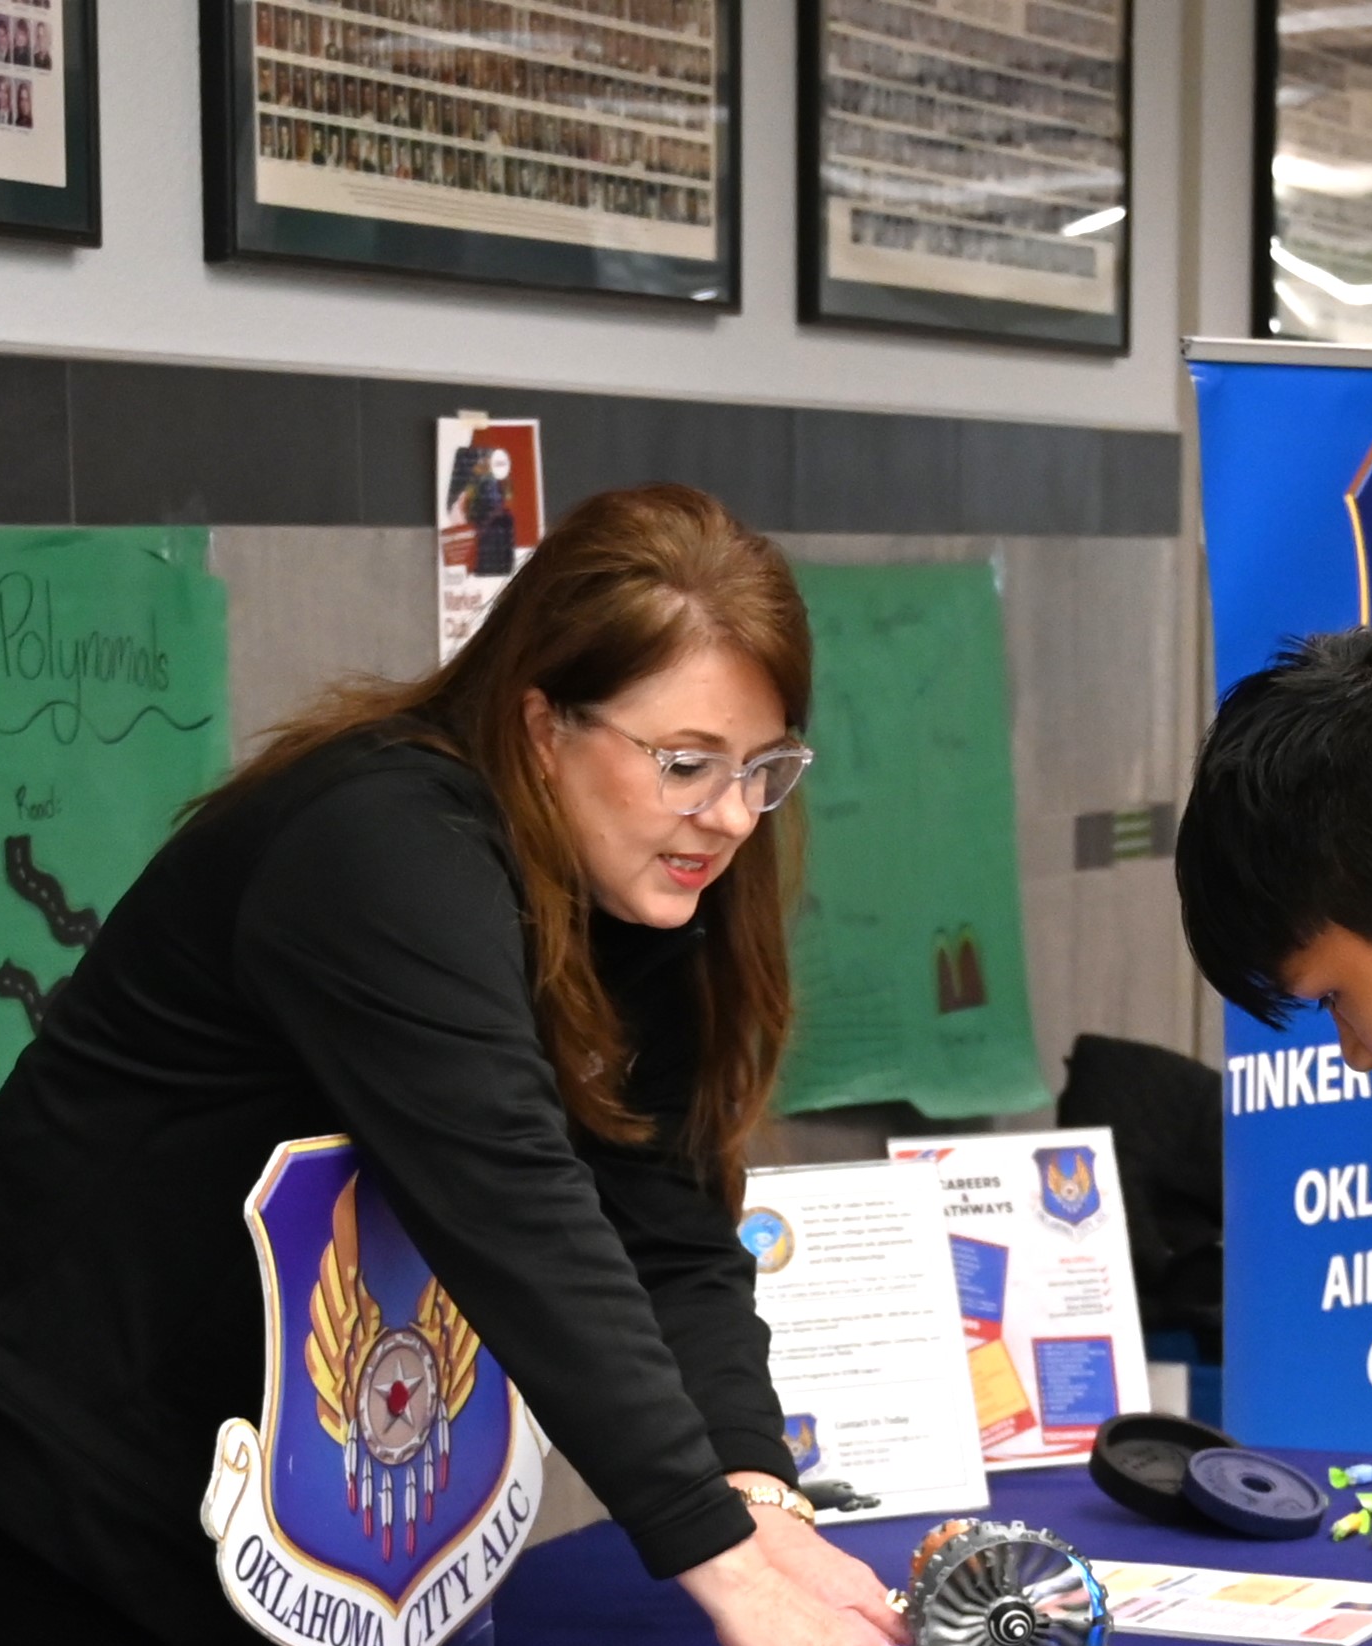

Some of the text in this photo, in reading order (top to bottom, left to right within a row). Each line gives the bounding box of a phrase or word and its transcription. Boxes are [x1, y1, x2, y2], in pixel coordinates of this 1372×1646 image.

[1228, 1043, 1371, 1116] TINKER
[943, 1201, 1014, 1217] ATHWAYS
[478, 1479, 530, 1582] ALC
